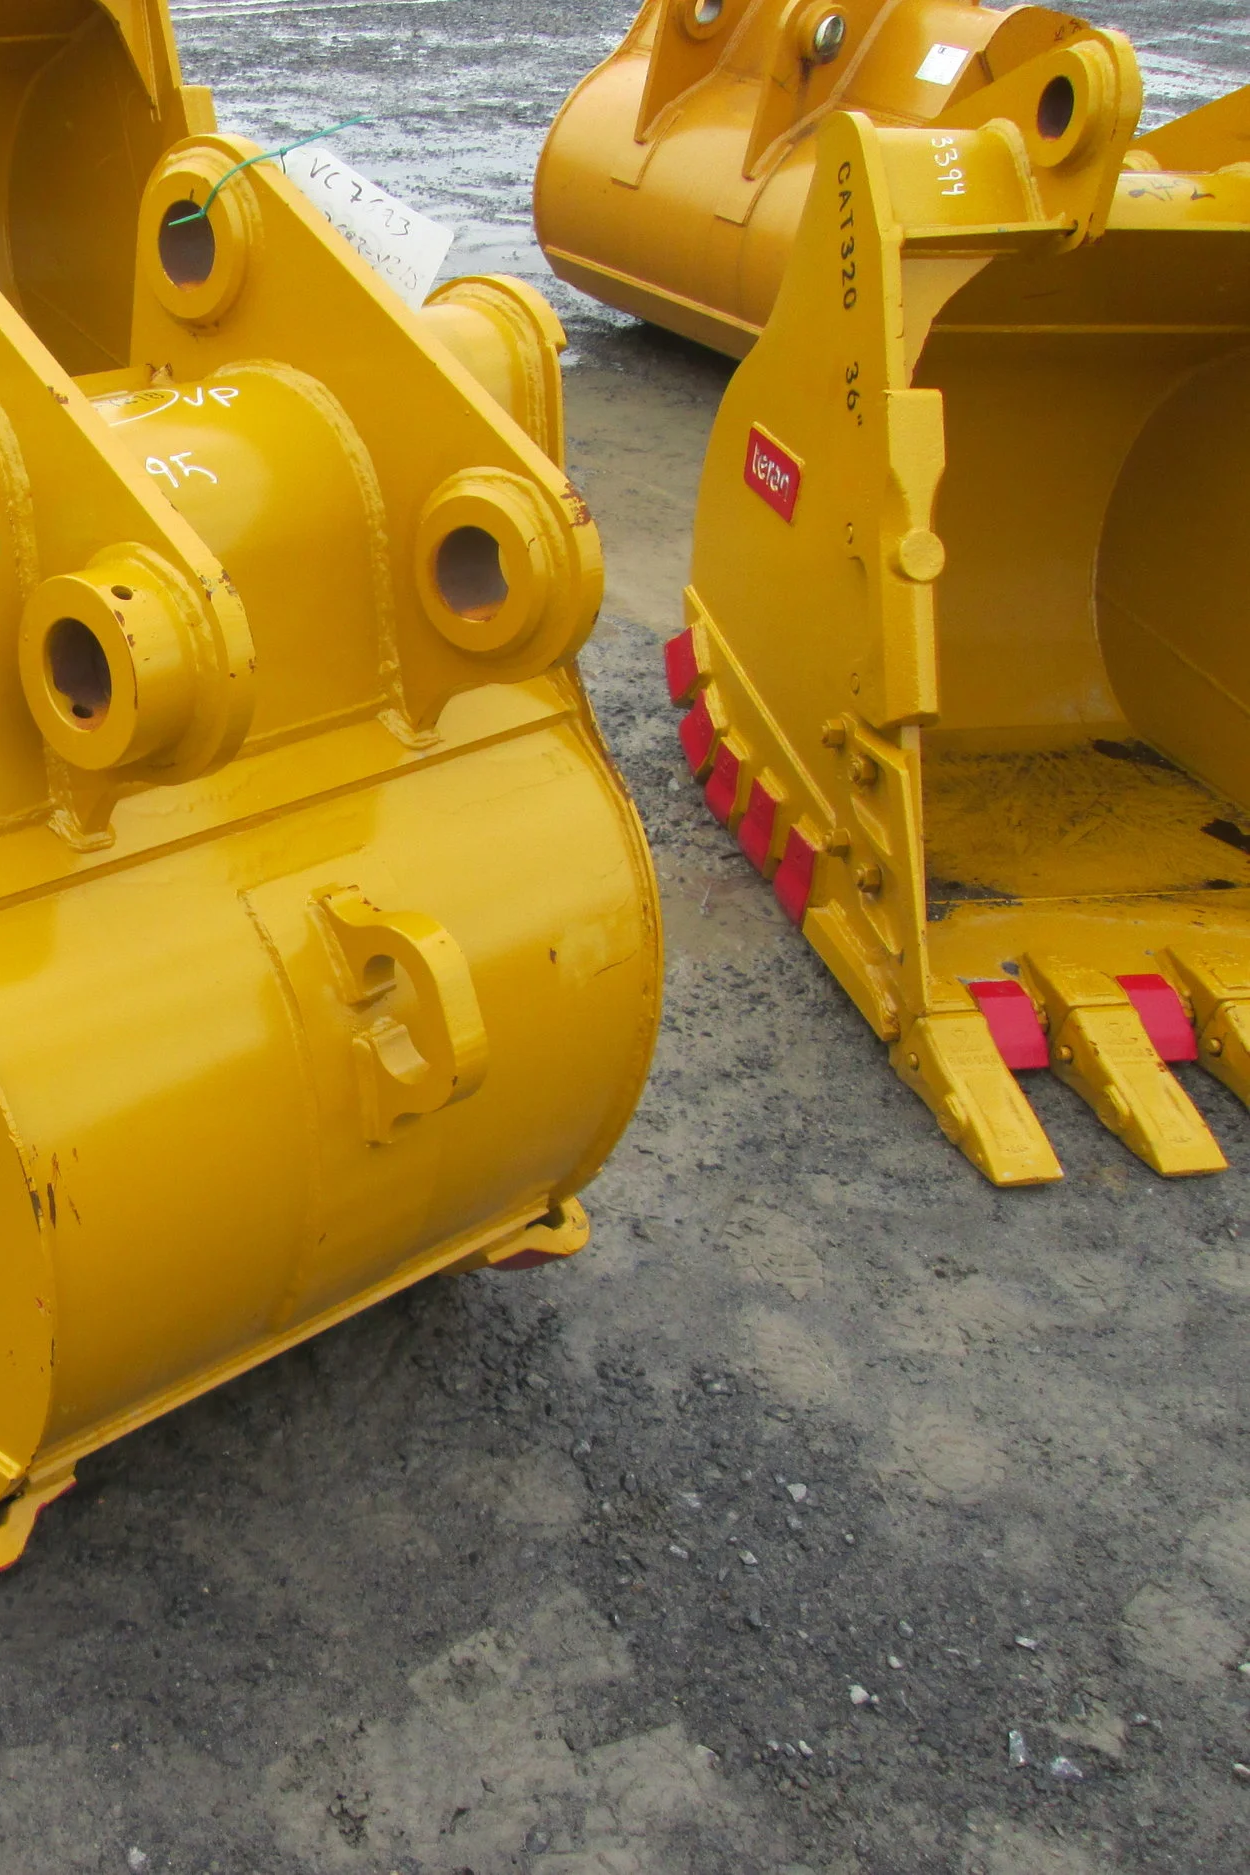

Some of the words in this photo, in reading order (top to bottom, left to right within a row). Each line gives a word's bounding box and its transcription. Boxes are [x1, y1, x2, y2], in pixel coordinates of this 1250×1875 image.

[931, 135, 967, 197] 3394
[837, 161, 858, 310] CAT320
[844, 362, 863, 428] 36"
